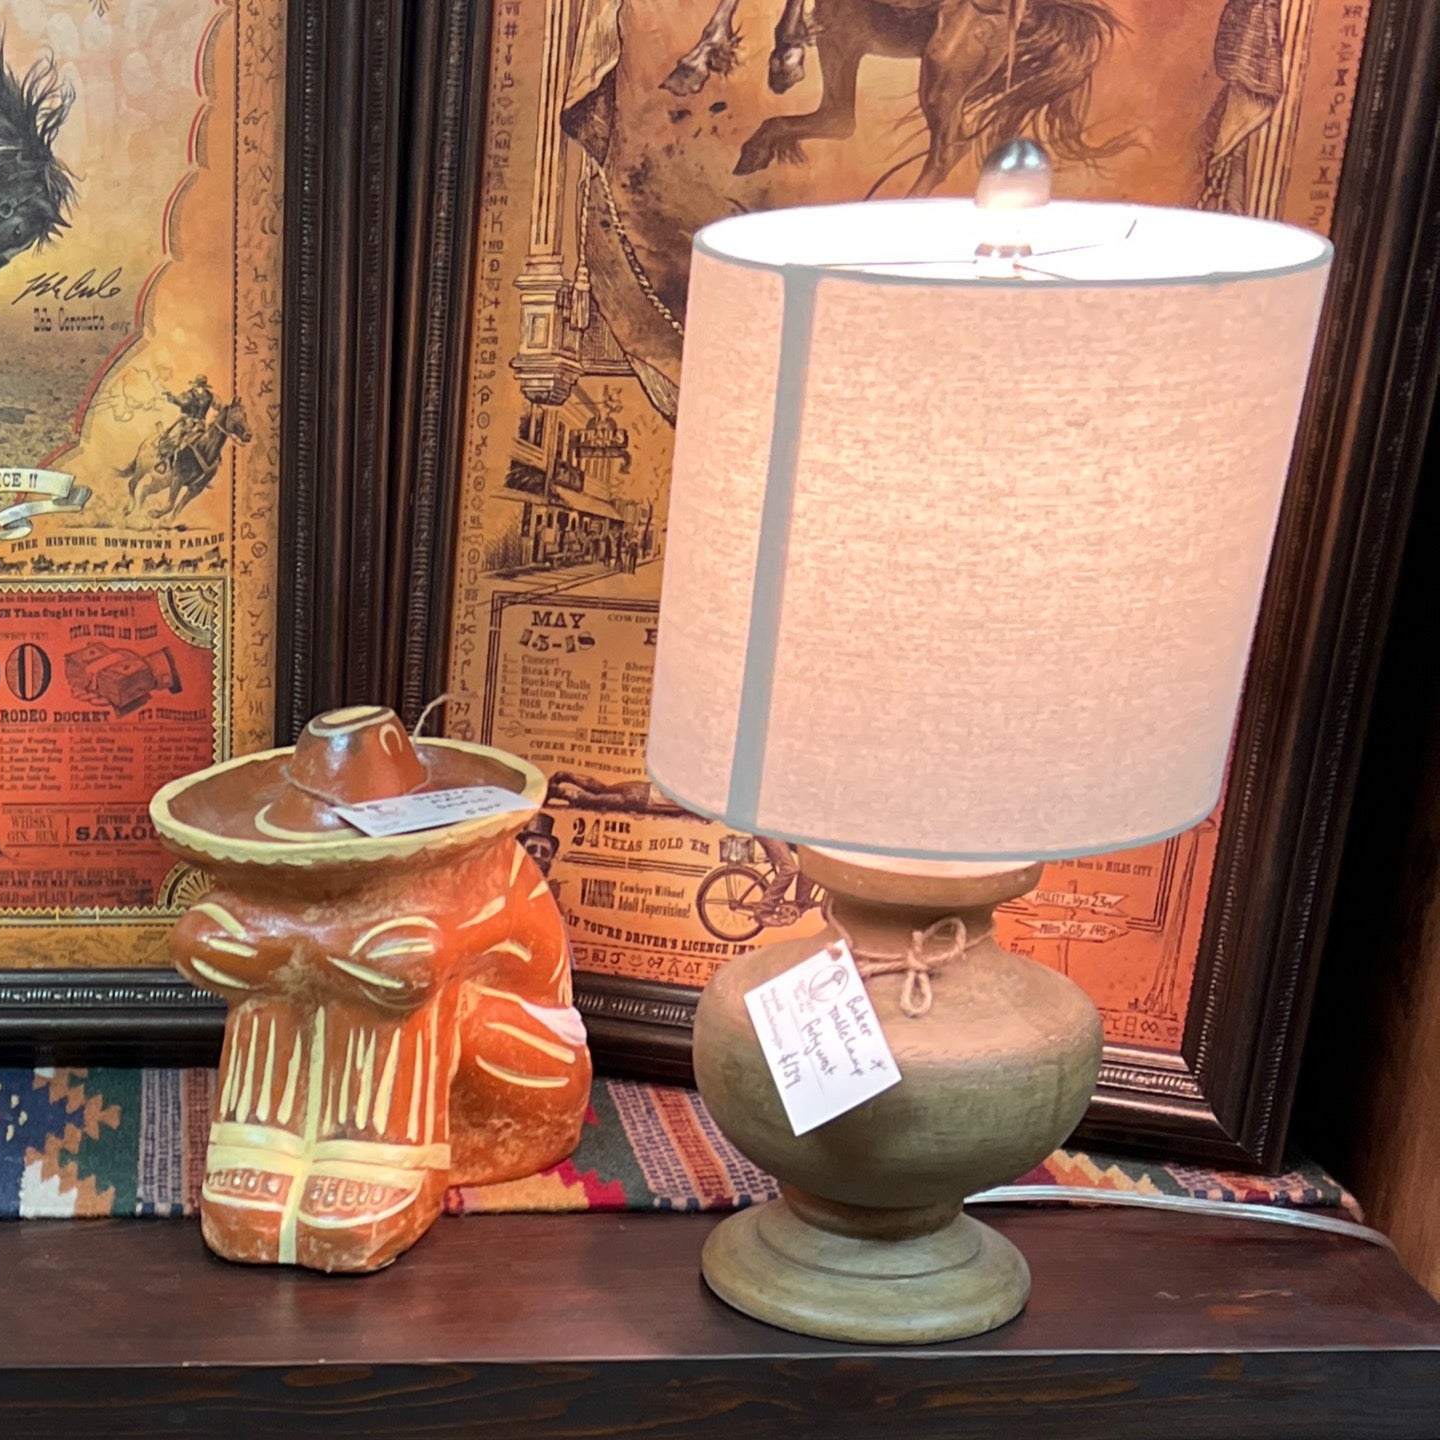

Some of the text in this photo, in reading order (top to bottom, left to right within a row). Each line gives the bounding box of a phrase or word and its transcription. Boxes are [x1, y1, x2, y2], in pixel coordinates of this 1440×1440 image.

[11, 532, 226, 553] FREE HISTORIC DOWNTOWN PARADE
[14, 608, 40, 619] Than
[100, 607, 126, 619] Legal
[531, 610, 586, 630] MAY
[607, 613, 659, 625] COWBOY
[521, 654, 560, 666] Concert
[521, 665, 572, 680] Steak Fry
[521, 677, 563, 690] Bucking
[521, 686, 558, 698] Mutton
[547, 701, 585, 711] Parade
[0, 709, 111, 723] RODEO DOCKET
[518, 709, 580, 722] Trade Show
[530, 740, 637, 757] CURES FOR EVERY
[10, 815, 56, 829] WHISKY
[572, 817, 602, 849] 24
[604, 835, 643, 852] TEXAS
[649, 838, 684, 851] HOLD
[1106, 861, 1153, 877] MILES CITY
[619, 880, 652, 899] Cowboys
[583, 919, 730, 956] YOU'RE DRIVER'S LICENCE
[777, 1052, 803, 1090] $139
